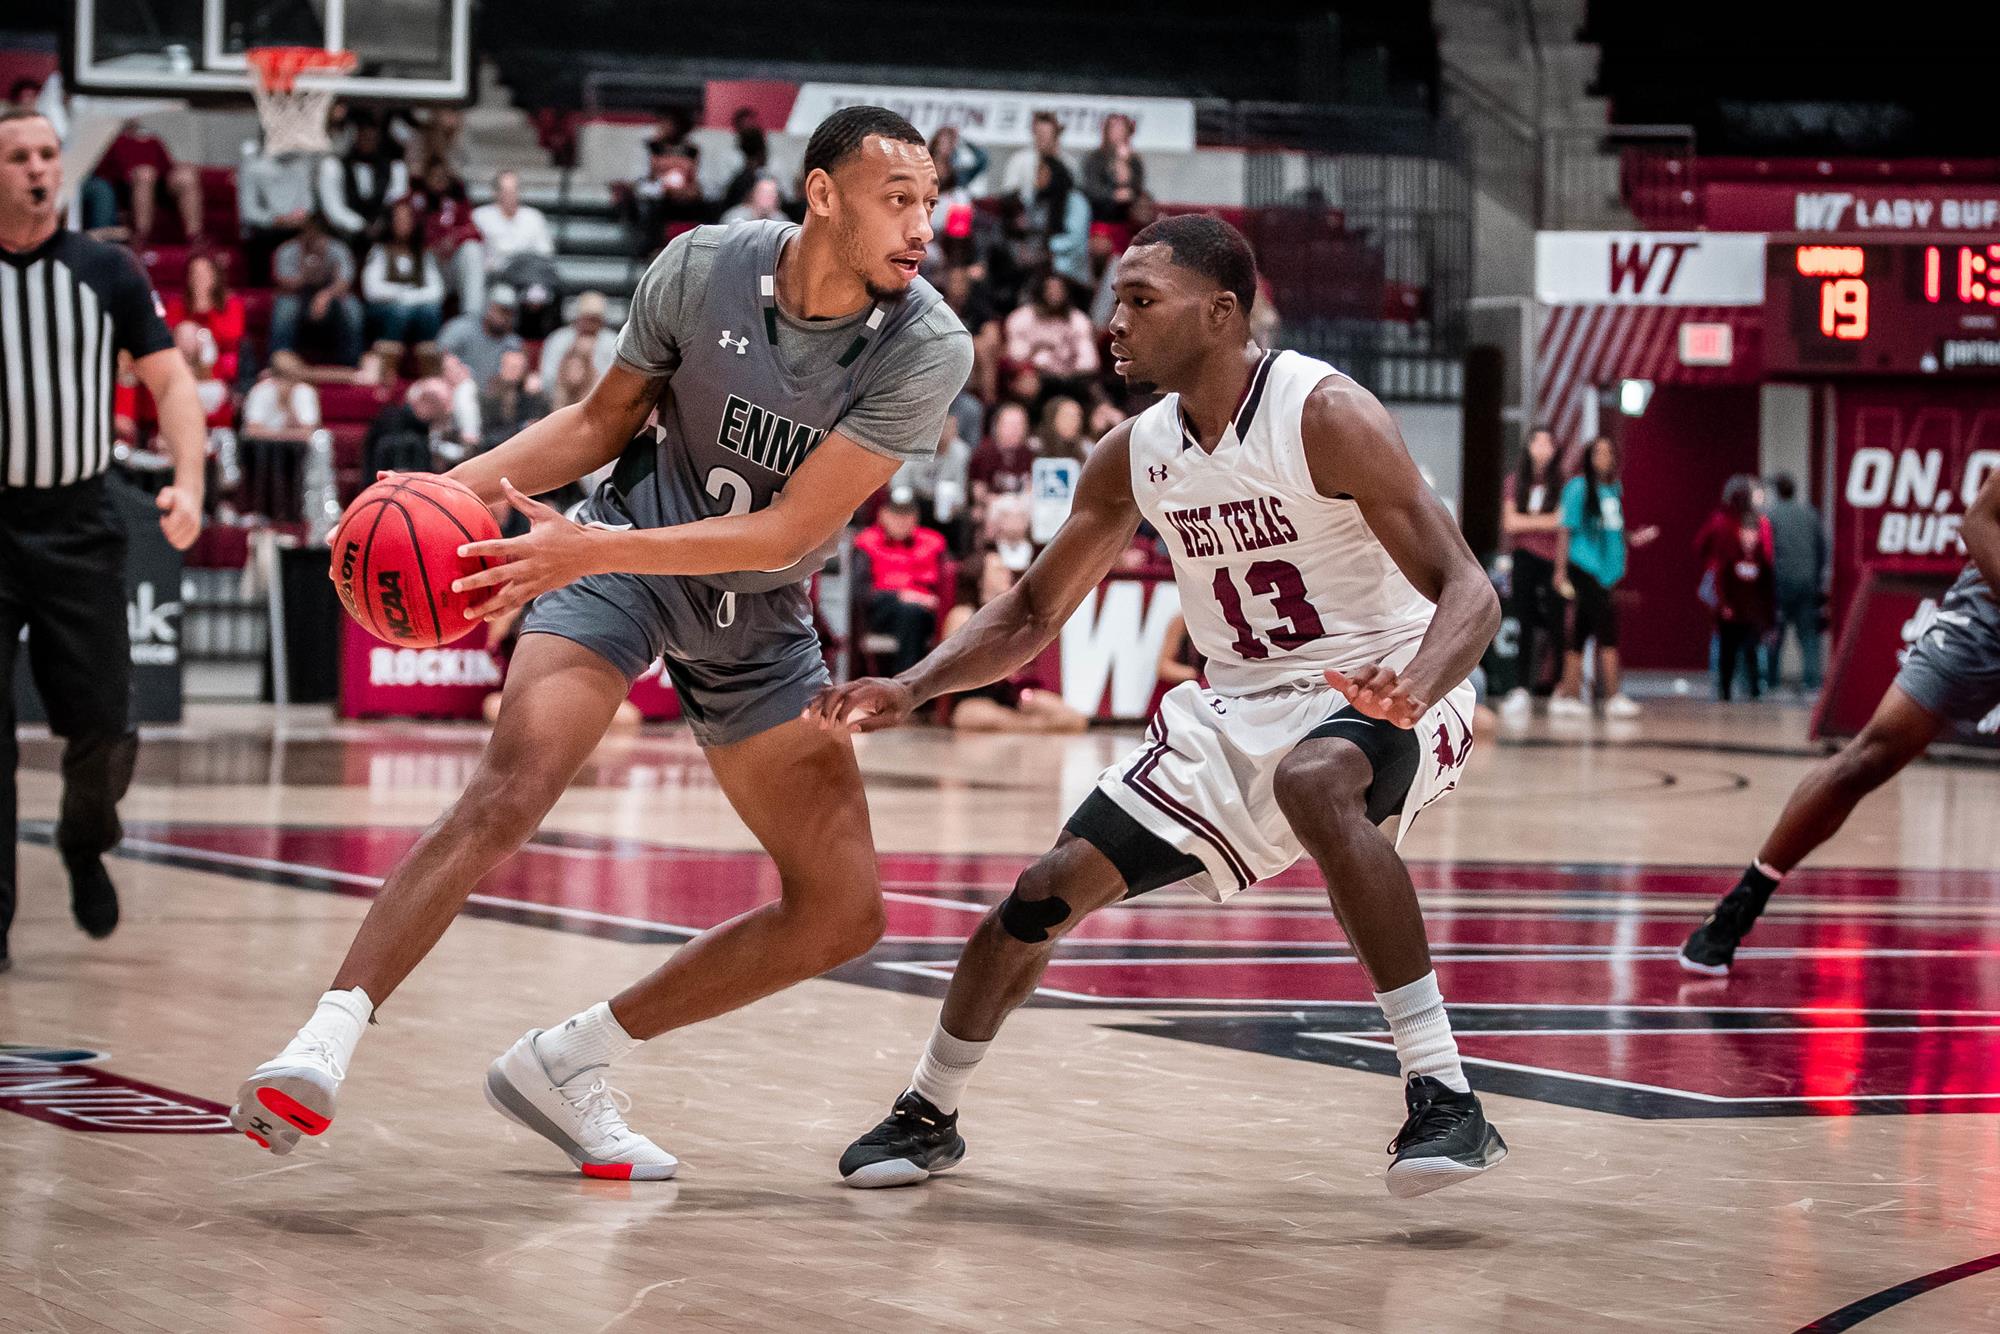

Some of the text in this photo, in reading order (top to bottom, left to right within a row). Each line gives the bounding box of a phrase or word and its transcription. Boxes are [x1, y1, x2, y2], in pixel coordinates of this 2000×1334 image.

[1796, 192, 1853, 231] WT
[1856, 200, 1933, 228] LADY
[1609, 242, 1699, 294] WT
[1821, 279, 1869, 340] 19
[717, 393, 828, 477] ENM
[1846, 447, 1953, 513] ON,
[1164, 495, 1299, 558] WEST TEXAS
[1877, 512, 1968, 555] BUF
[377, 571, 417, 640] NCAA
[1212, 558, 1326, 660] 13
